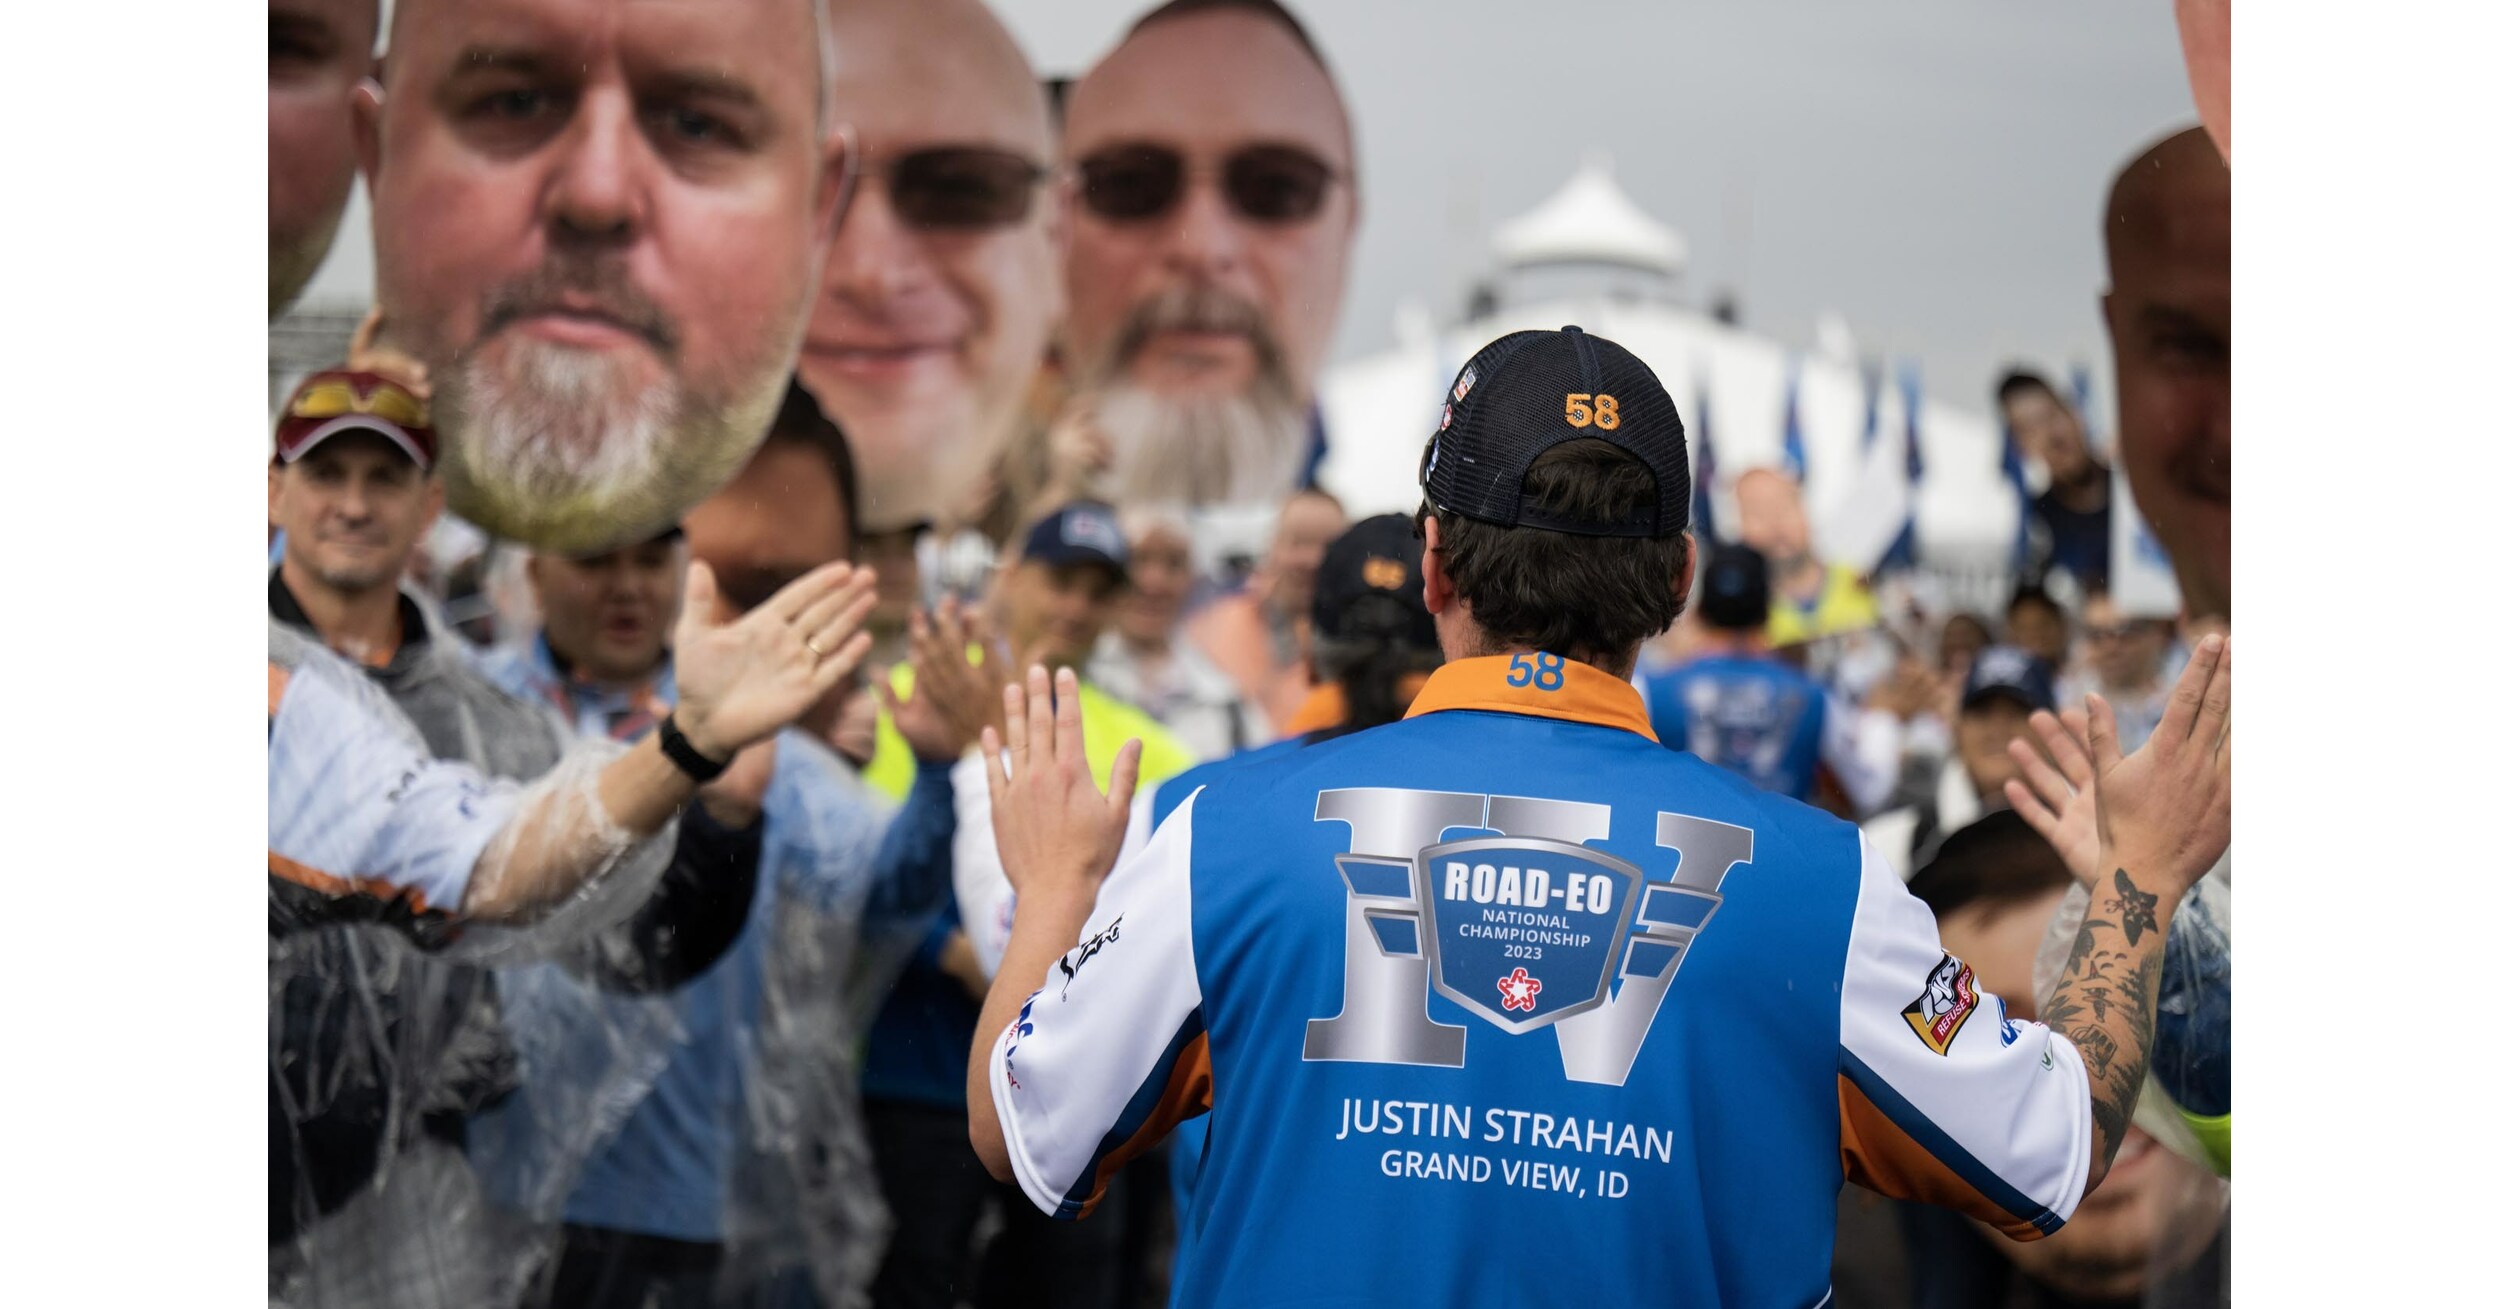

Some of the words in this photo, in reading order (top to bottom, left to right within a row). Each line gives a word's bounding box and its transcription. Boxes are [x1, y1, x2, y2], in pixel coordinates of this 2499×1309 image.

[1565, 393, 1620, 430] 58
[1506, 651, 1565, 691] 58
[1444, 862, 1613, 914] ROAD-EO
[1302, 787, 1754, 1086] IV
[1459, 923, 1591, 948] CHAMPIONSHIP
[1482, 909, 1570, 930] NATIONAL
[1503, 944, 1543, 960] 2023
[1937, 1000, 1966, 1036] REFUSE
[1336, 1098, 1472, 1140] JUSTIN
[1484, 1108, 1673, 1163] STRAHAN
[1380, 1150, 1491, 1183] GRAND
[1501, 1159, 1586, 1199] VIEW,
[1597, 1170, 1629, 1199] ID
